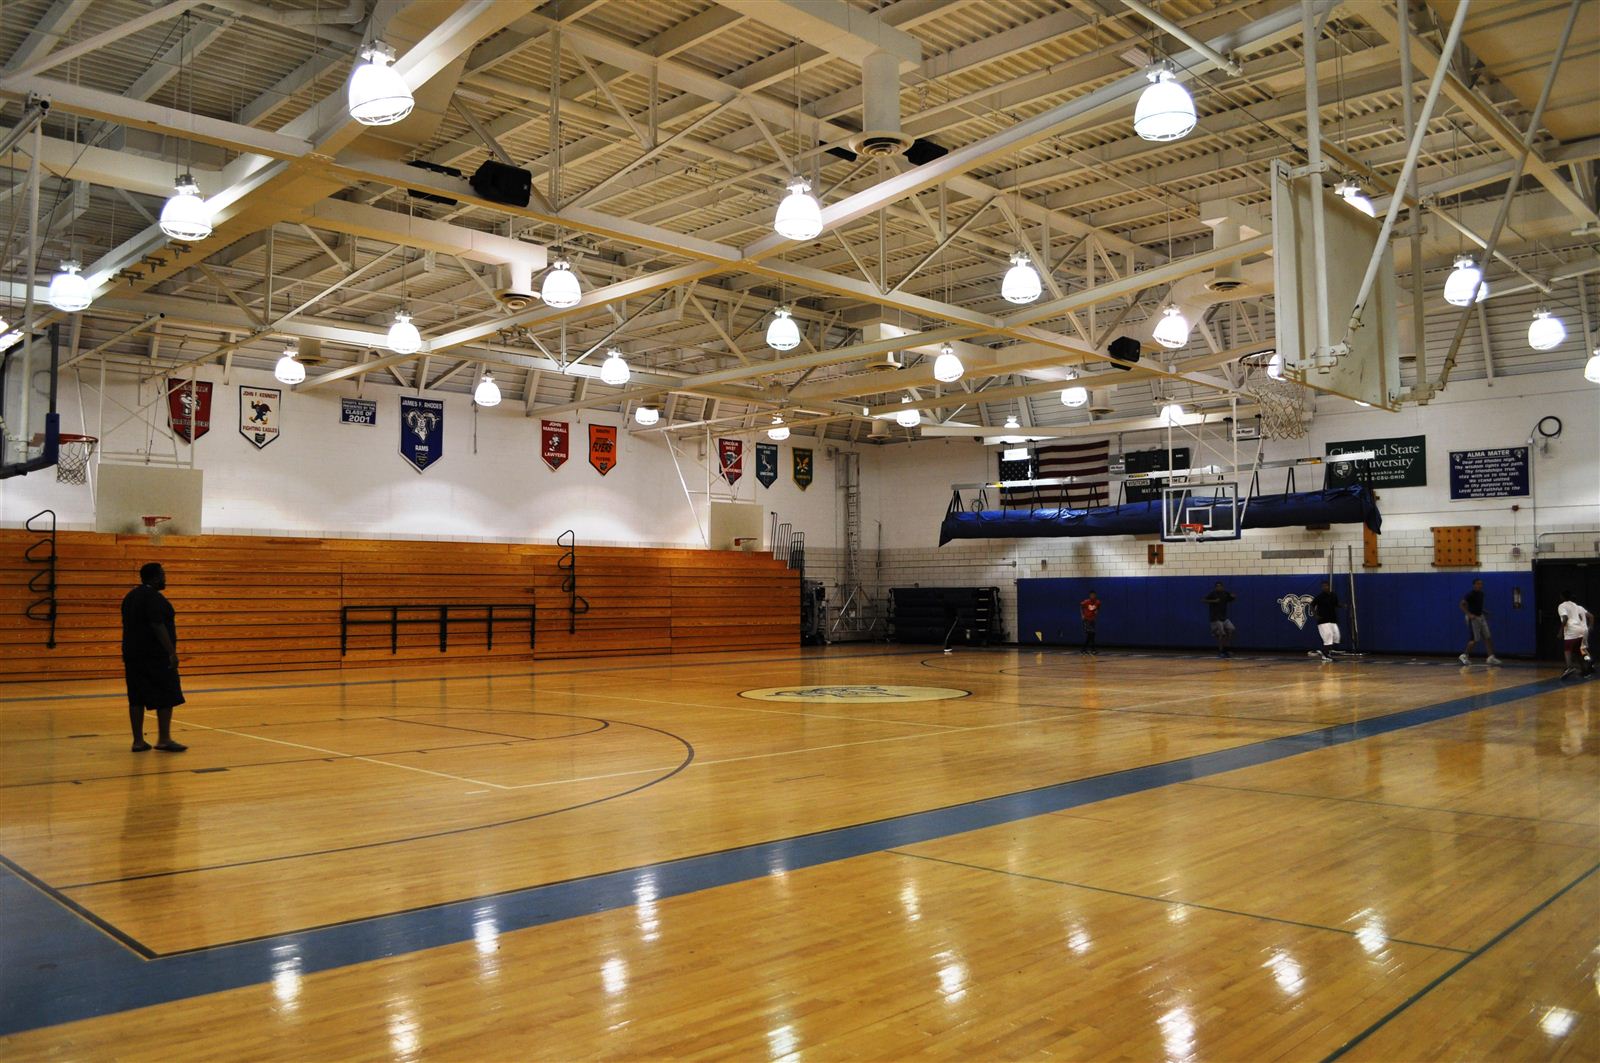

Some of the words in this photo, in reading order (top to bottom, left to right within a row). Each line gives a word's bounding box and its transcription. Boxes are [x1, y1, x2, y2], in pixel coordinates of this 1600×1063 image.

[348, 414, 370, 422] 2001
[1329, 444, 1387, 459] Cllnd
[1390, 444, 1420, 455] State
[1354, 456, 1414, 469] Uiversity
